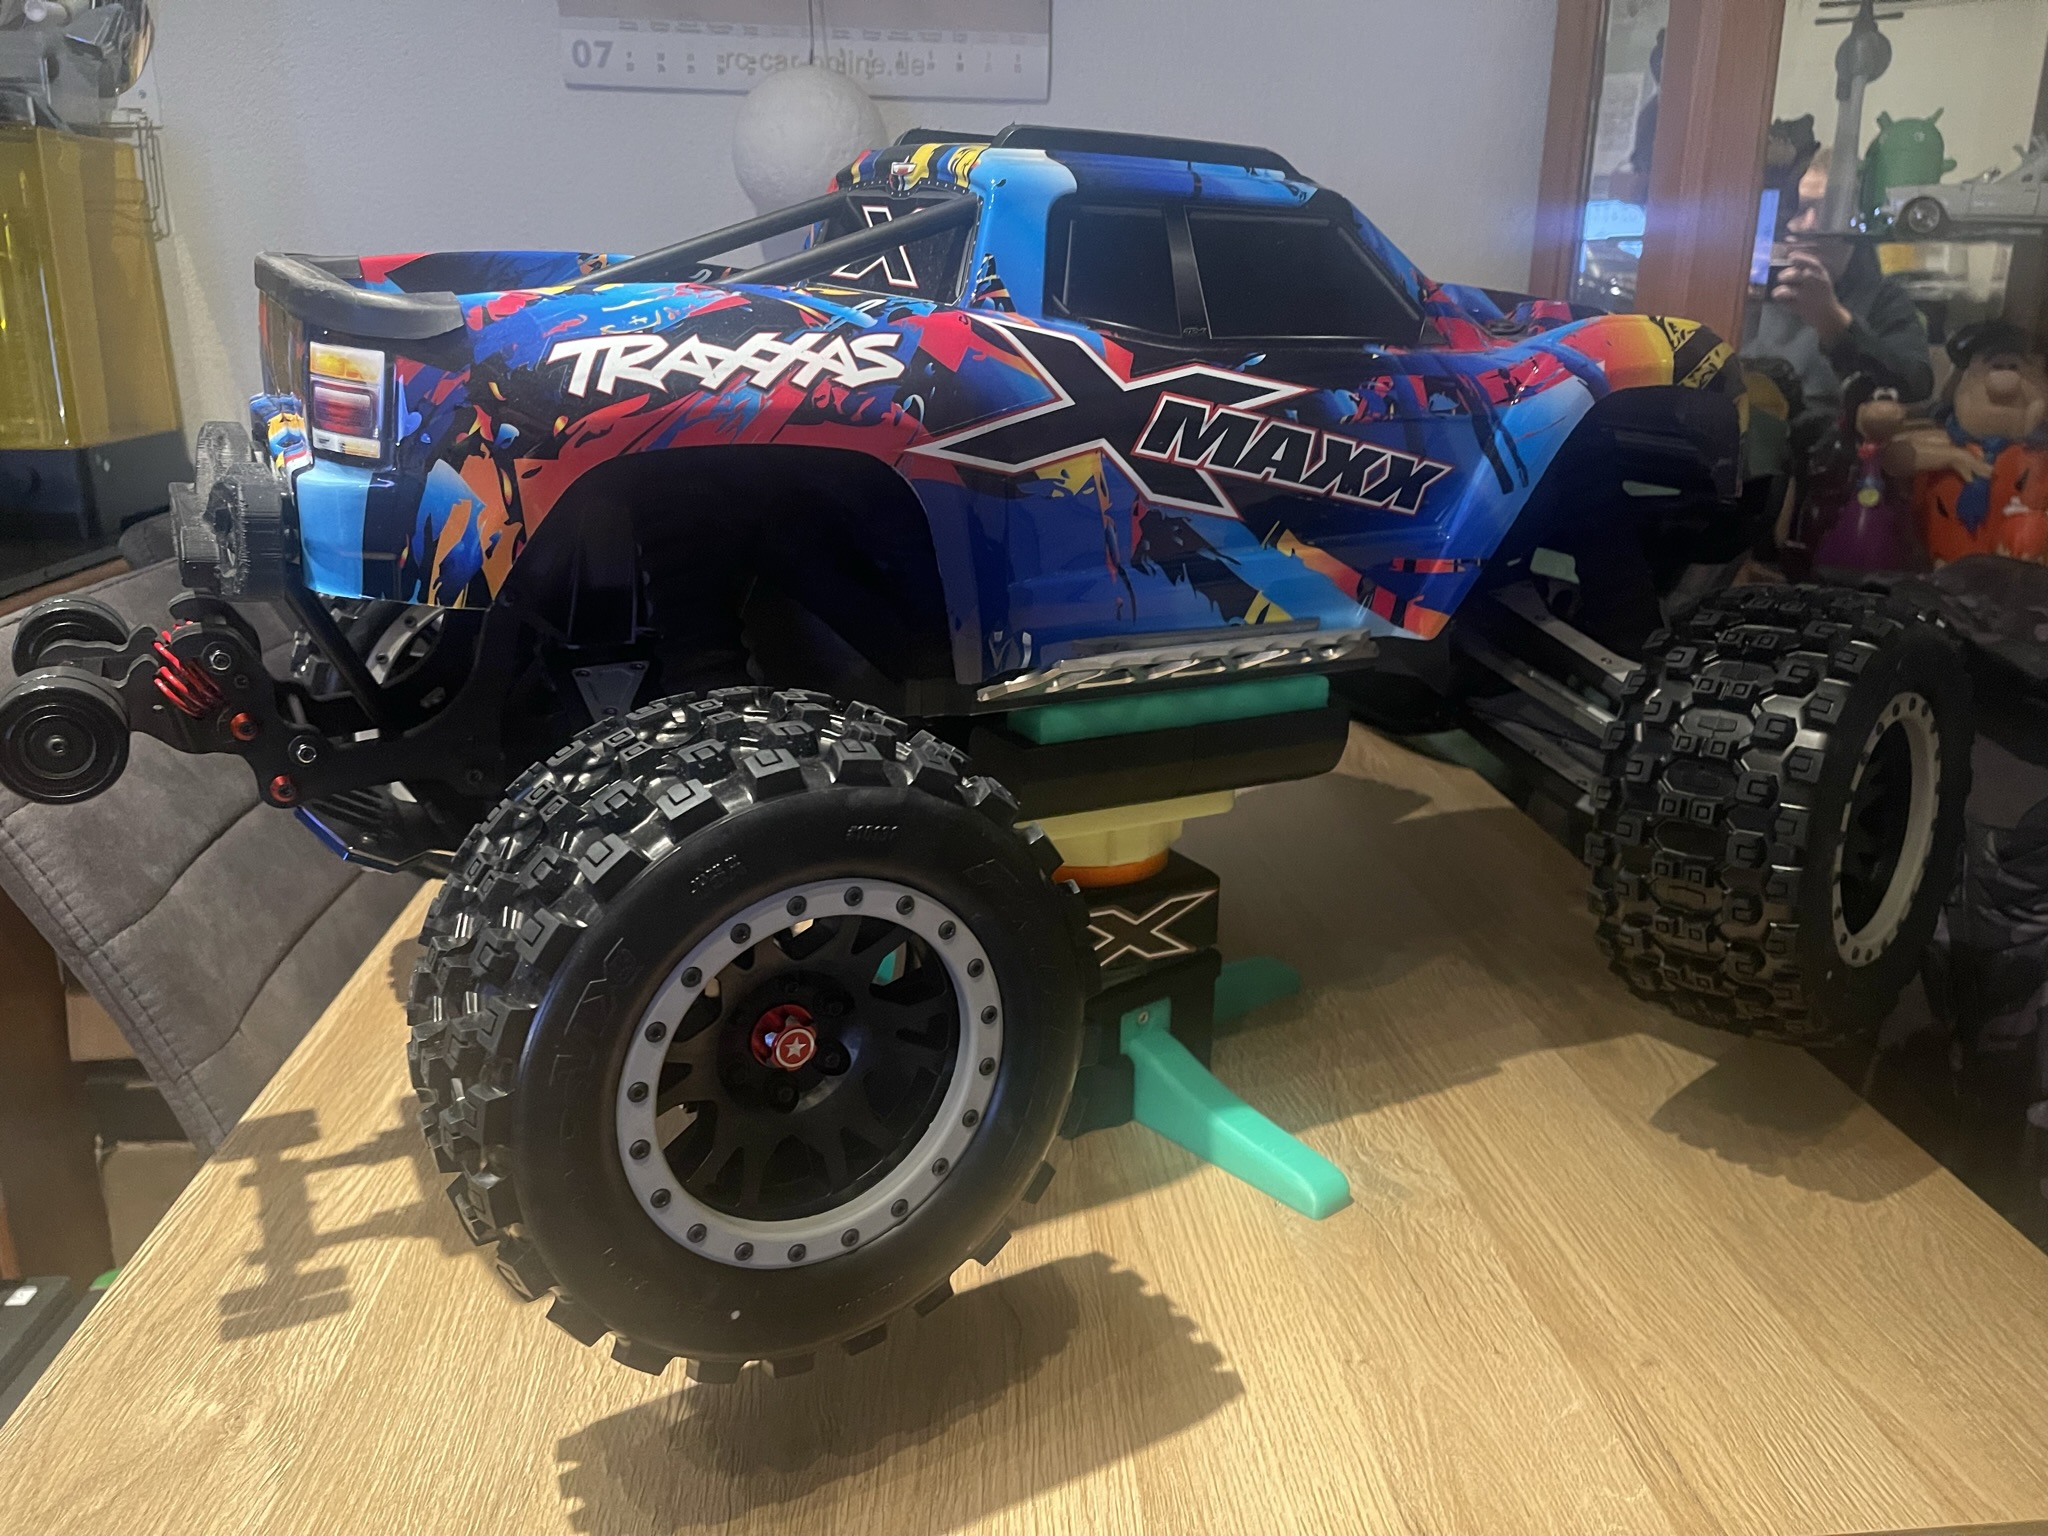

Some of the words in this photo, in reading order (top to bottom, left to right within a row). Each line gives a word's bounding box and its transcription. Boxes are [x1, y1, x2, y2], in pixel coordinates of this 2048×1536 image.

[571, 39, 614, 69] 07
[546, 332, 905, 398] TRAXXAS
[902, 310, 1317, 521] X
[1131, 391, 1454, 517] MAXX
